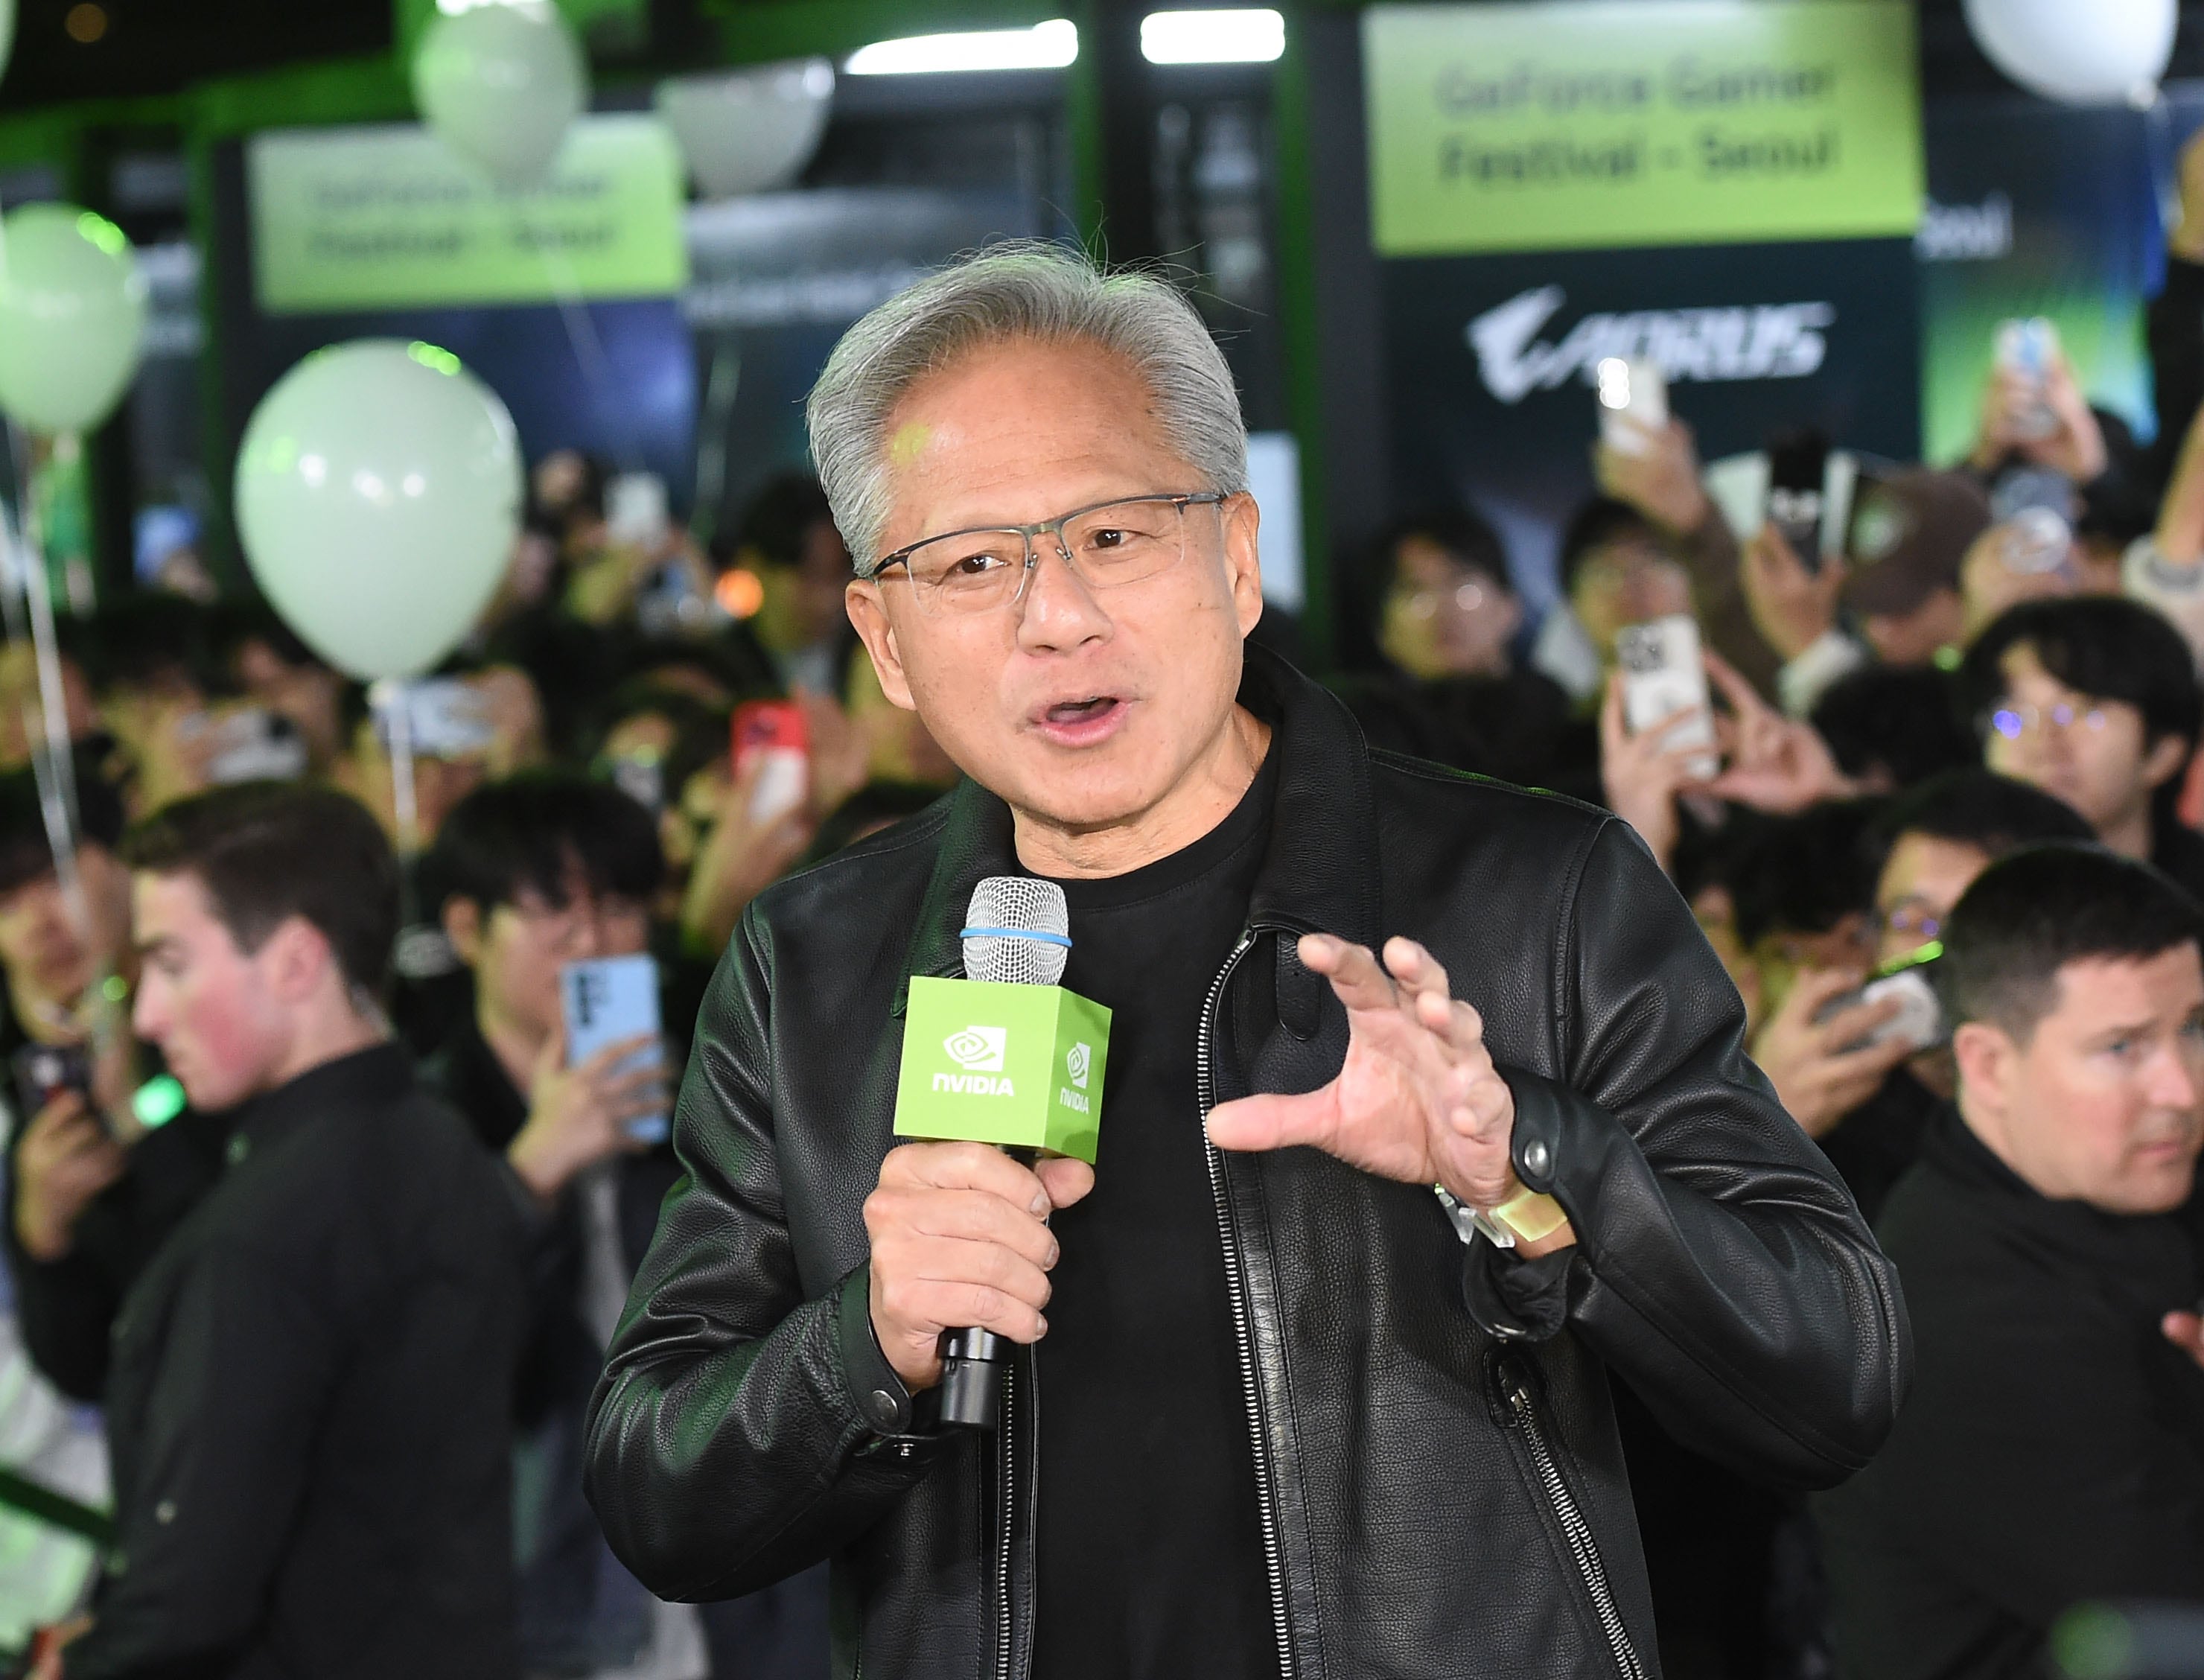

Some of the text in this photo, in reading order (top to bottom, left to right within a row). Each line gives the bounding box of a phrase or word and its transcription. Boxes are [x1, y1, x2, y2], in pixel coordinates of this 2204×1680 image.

[1436, 57, 1835, 116] GeForce Gamer
[1439, 133, 1647, 188] Festival
[1695, 124, 1838, 177] Seoul
[1543, 299, 1835, 387] AORUS
